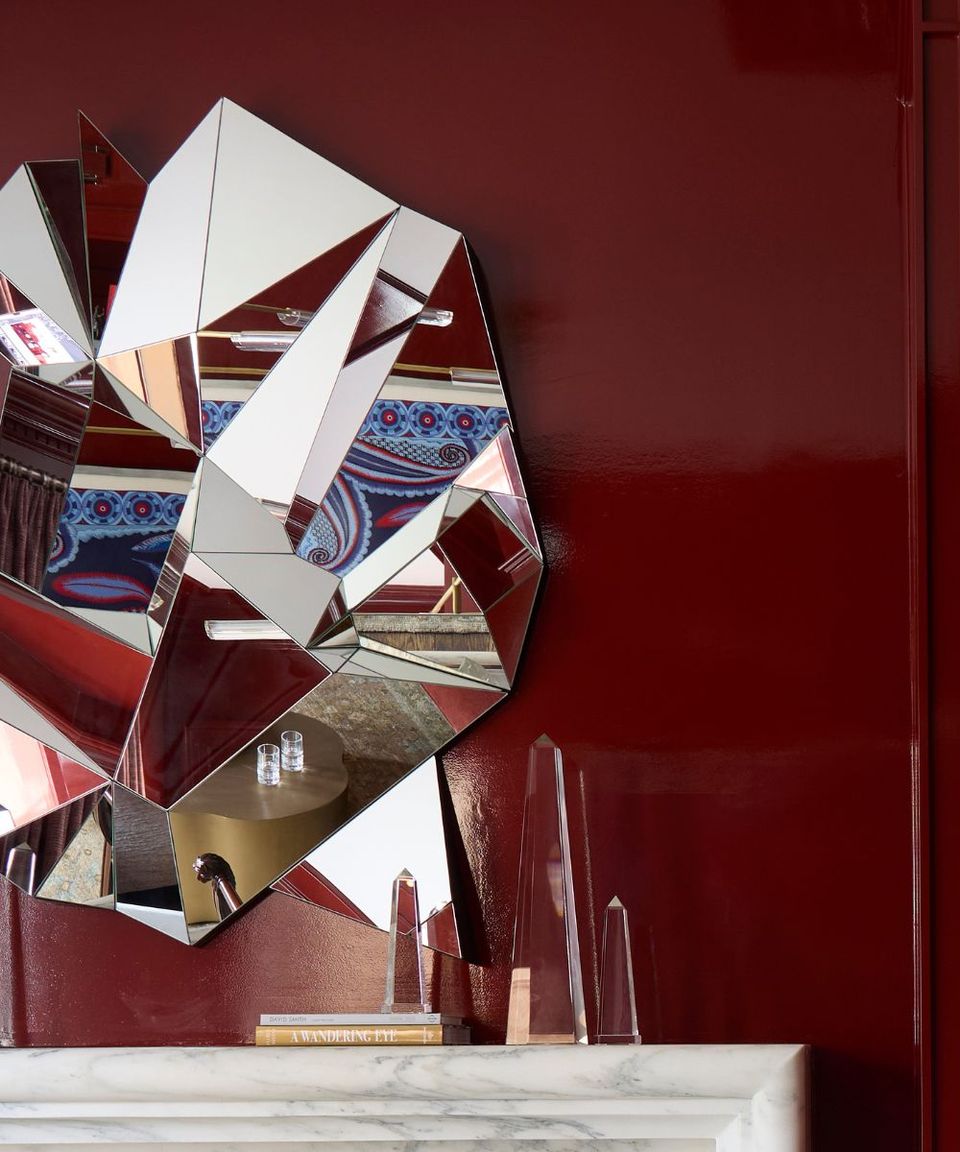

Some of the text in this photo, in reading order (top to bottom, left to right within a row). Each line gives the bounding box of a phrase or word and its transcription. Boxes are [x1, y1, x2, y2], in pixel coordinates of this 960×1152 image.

[290, 1030, 299, 1043] A
[300, 1029, 372, 1043] WANDERING
[374, 1029, 398, 1042] EYE
